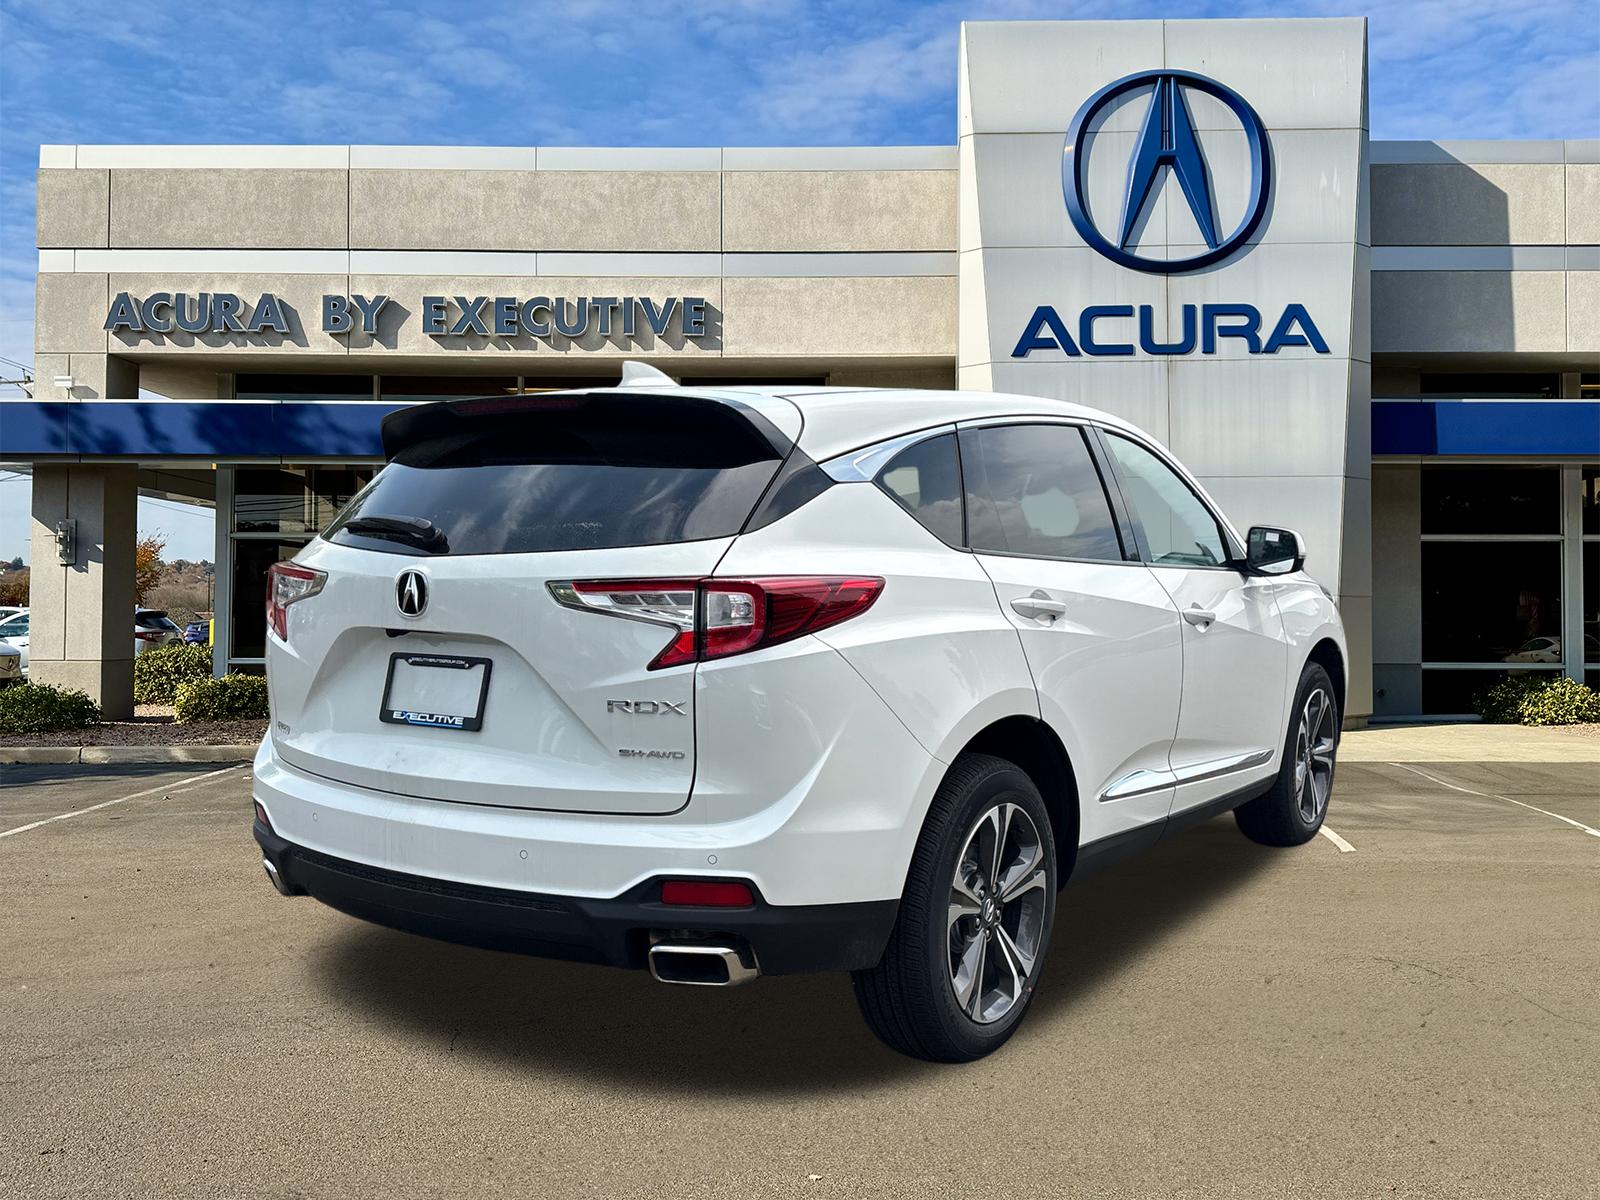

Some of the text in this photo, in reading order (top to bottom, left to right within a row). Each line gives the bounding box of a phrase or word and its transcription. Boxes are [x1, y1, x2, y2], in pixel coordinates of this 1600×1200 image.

[103, 292, 707, 337] ACURA BY EXECUTIVE
[1011, 303, 1331, 357] ACURA
[393, 711, 464, 725] EXECUTIVE
[607, 699, 687, 716] RDX
